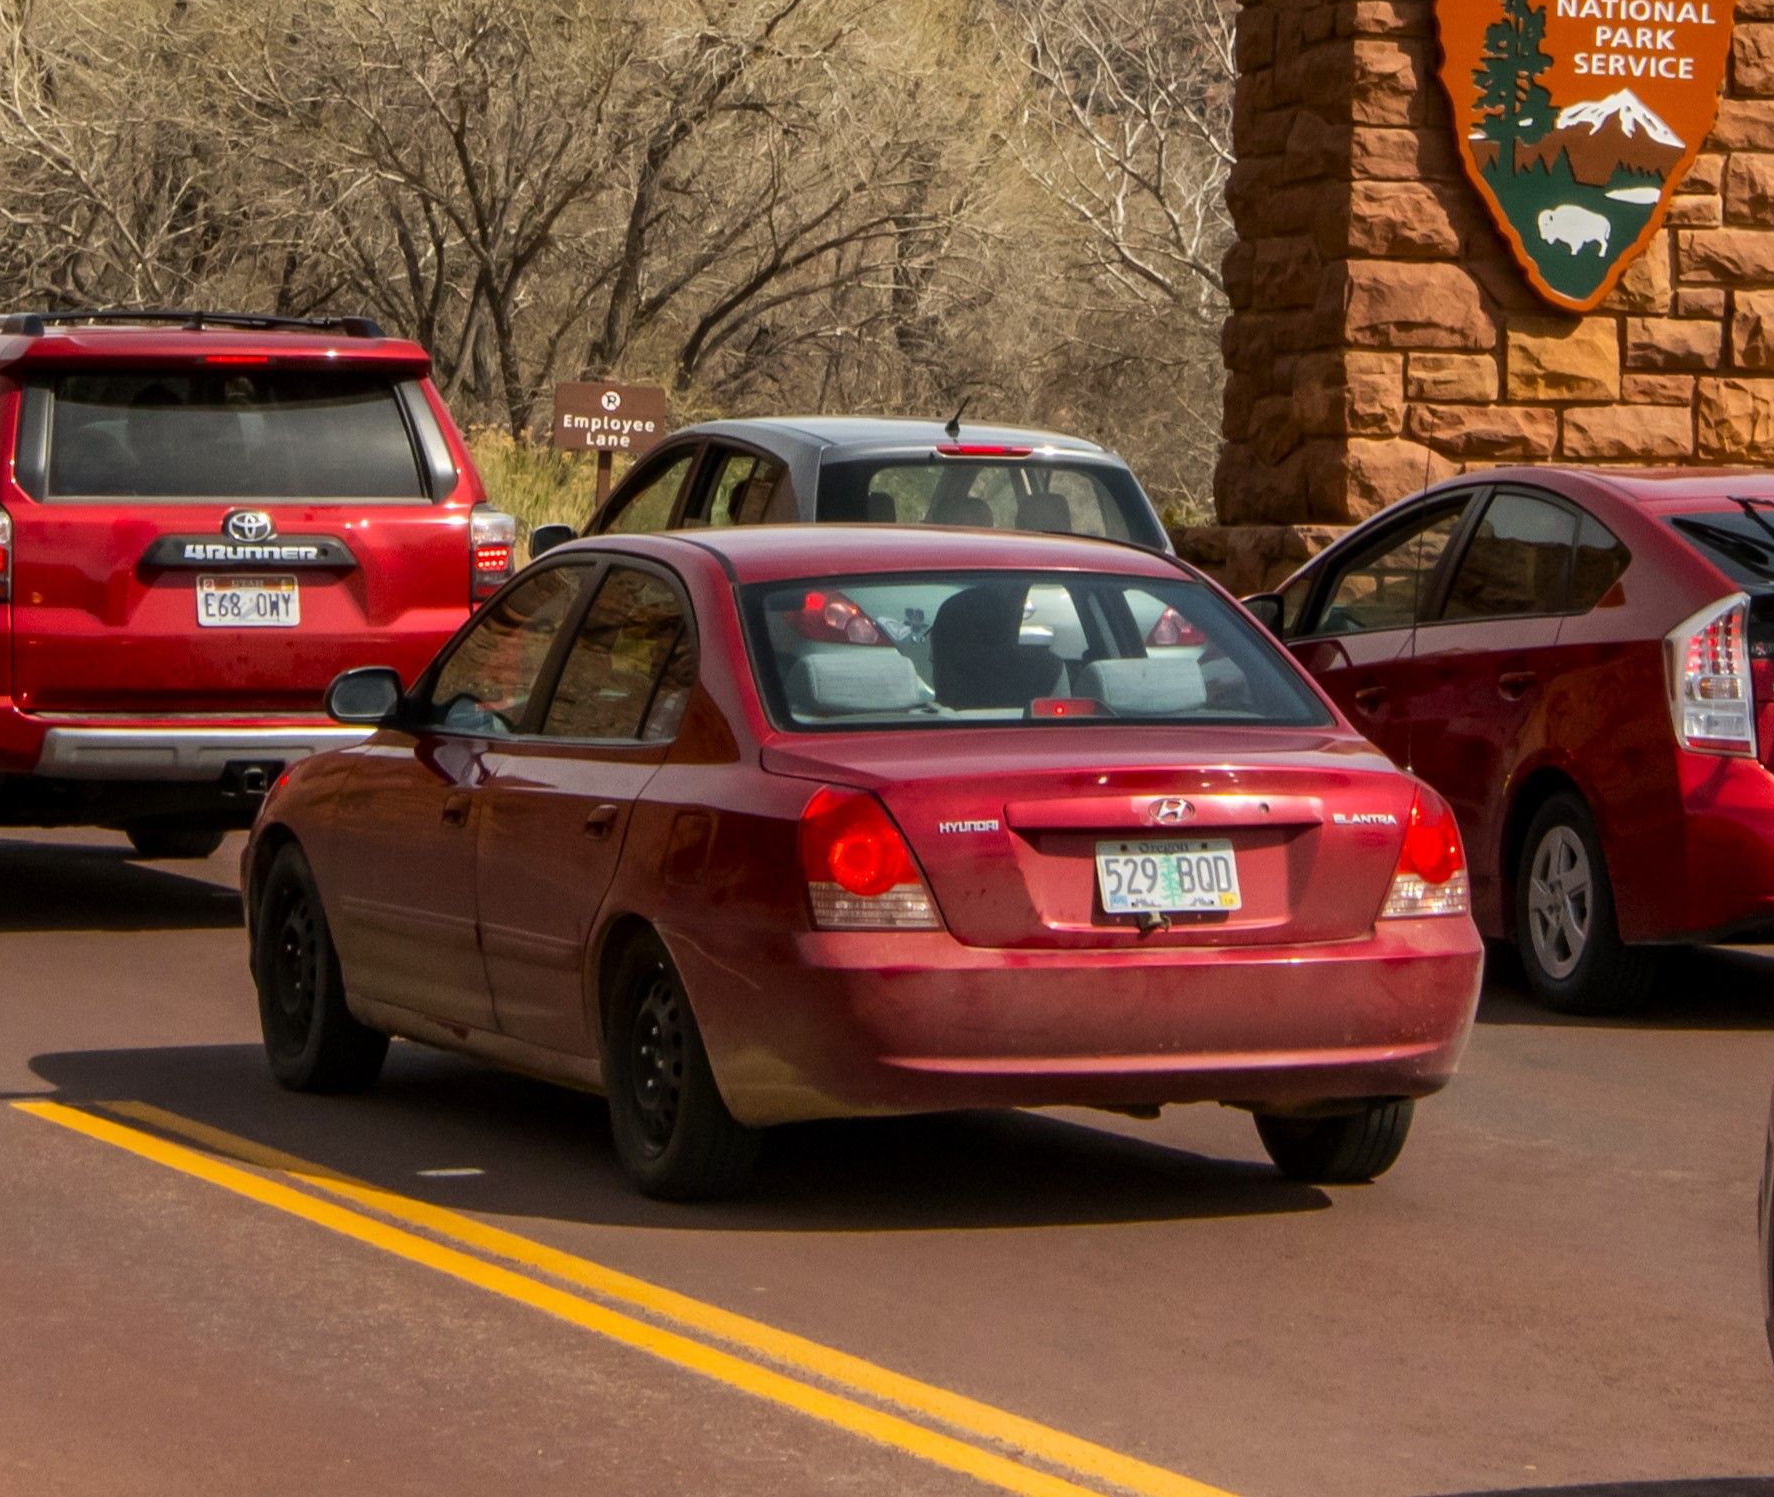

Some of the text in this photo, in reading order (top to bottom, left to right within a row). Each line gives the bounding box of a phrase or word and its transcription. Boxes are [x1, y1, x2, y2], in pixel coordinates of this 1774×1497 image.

[1595, 25, 1676, 50] PARK
[1574, 52, 1694, 79] SERVICE
[563, 414, 656, 434] Employee
[586, 431, 631, 447] Lane
[183, 543, 319, 560] 4RUNNER
[205, 592, 241, 617] E68
[938, 819, 999, 833] HYUNDAI
[1332, 812, 1397, 825] ELANTRA
[1139, 842, 1190, 855] Oregon
[1104, 856, 1233, 895] 529 BQD
